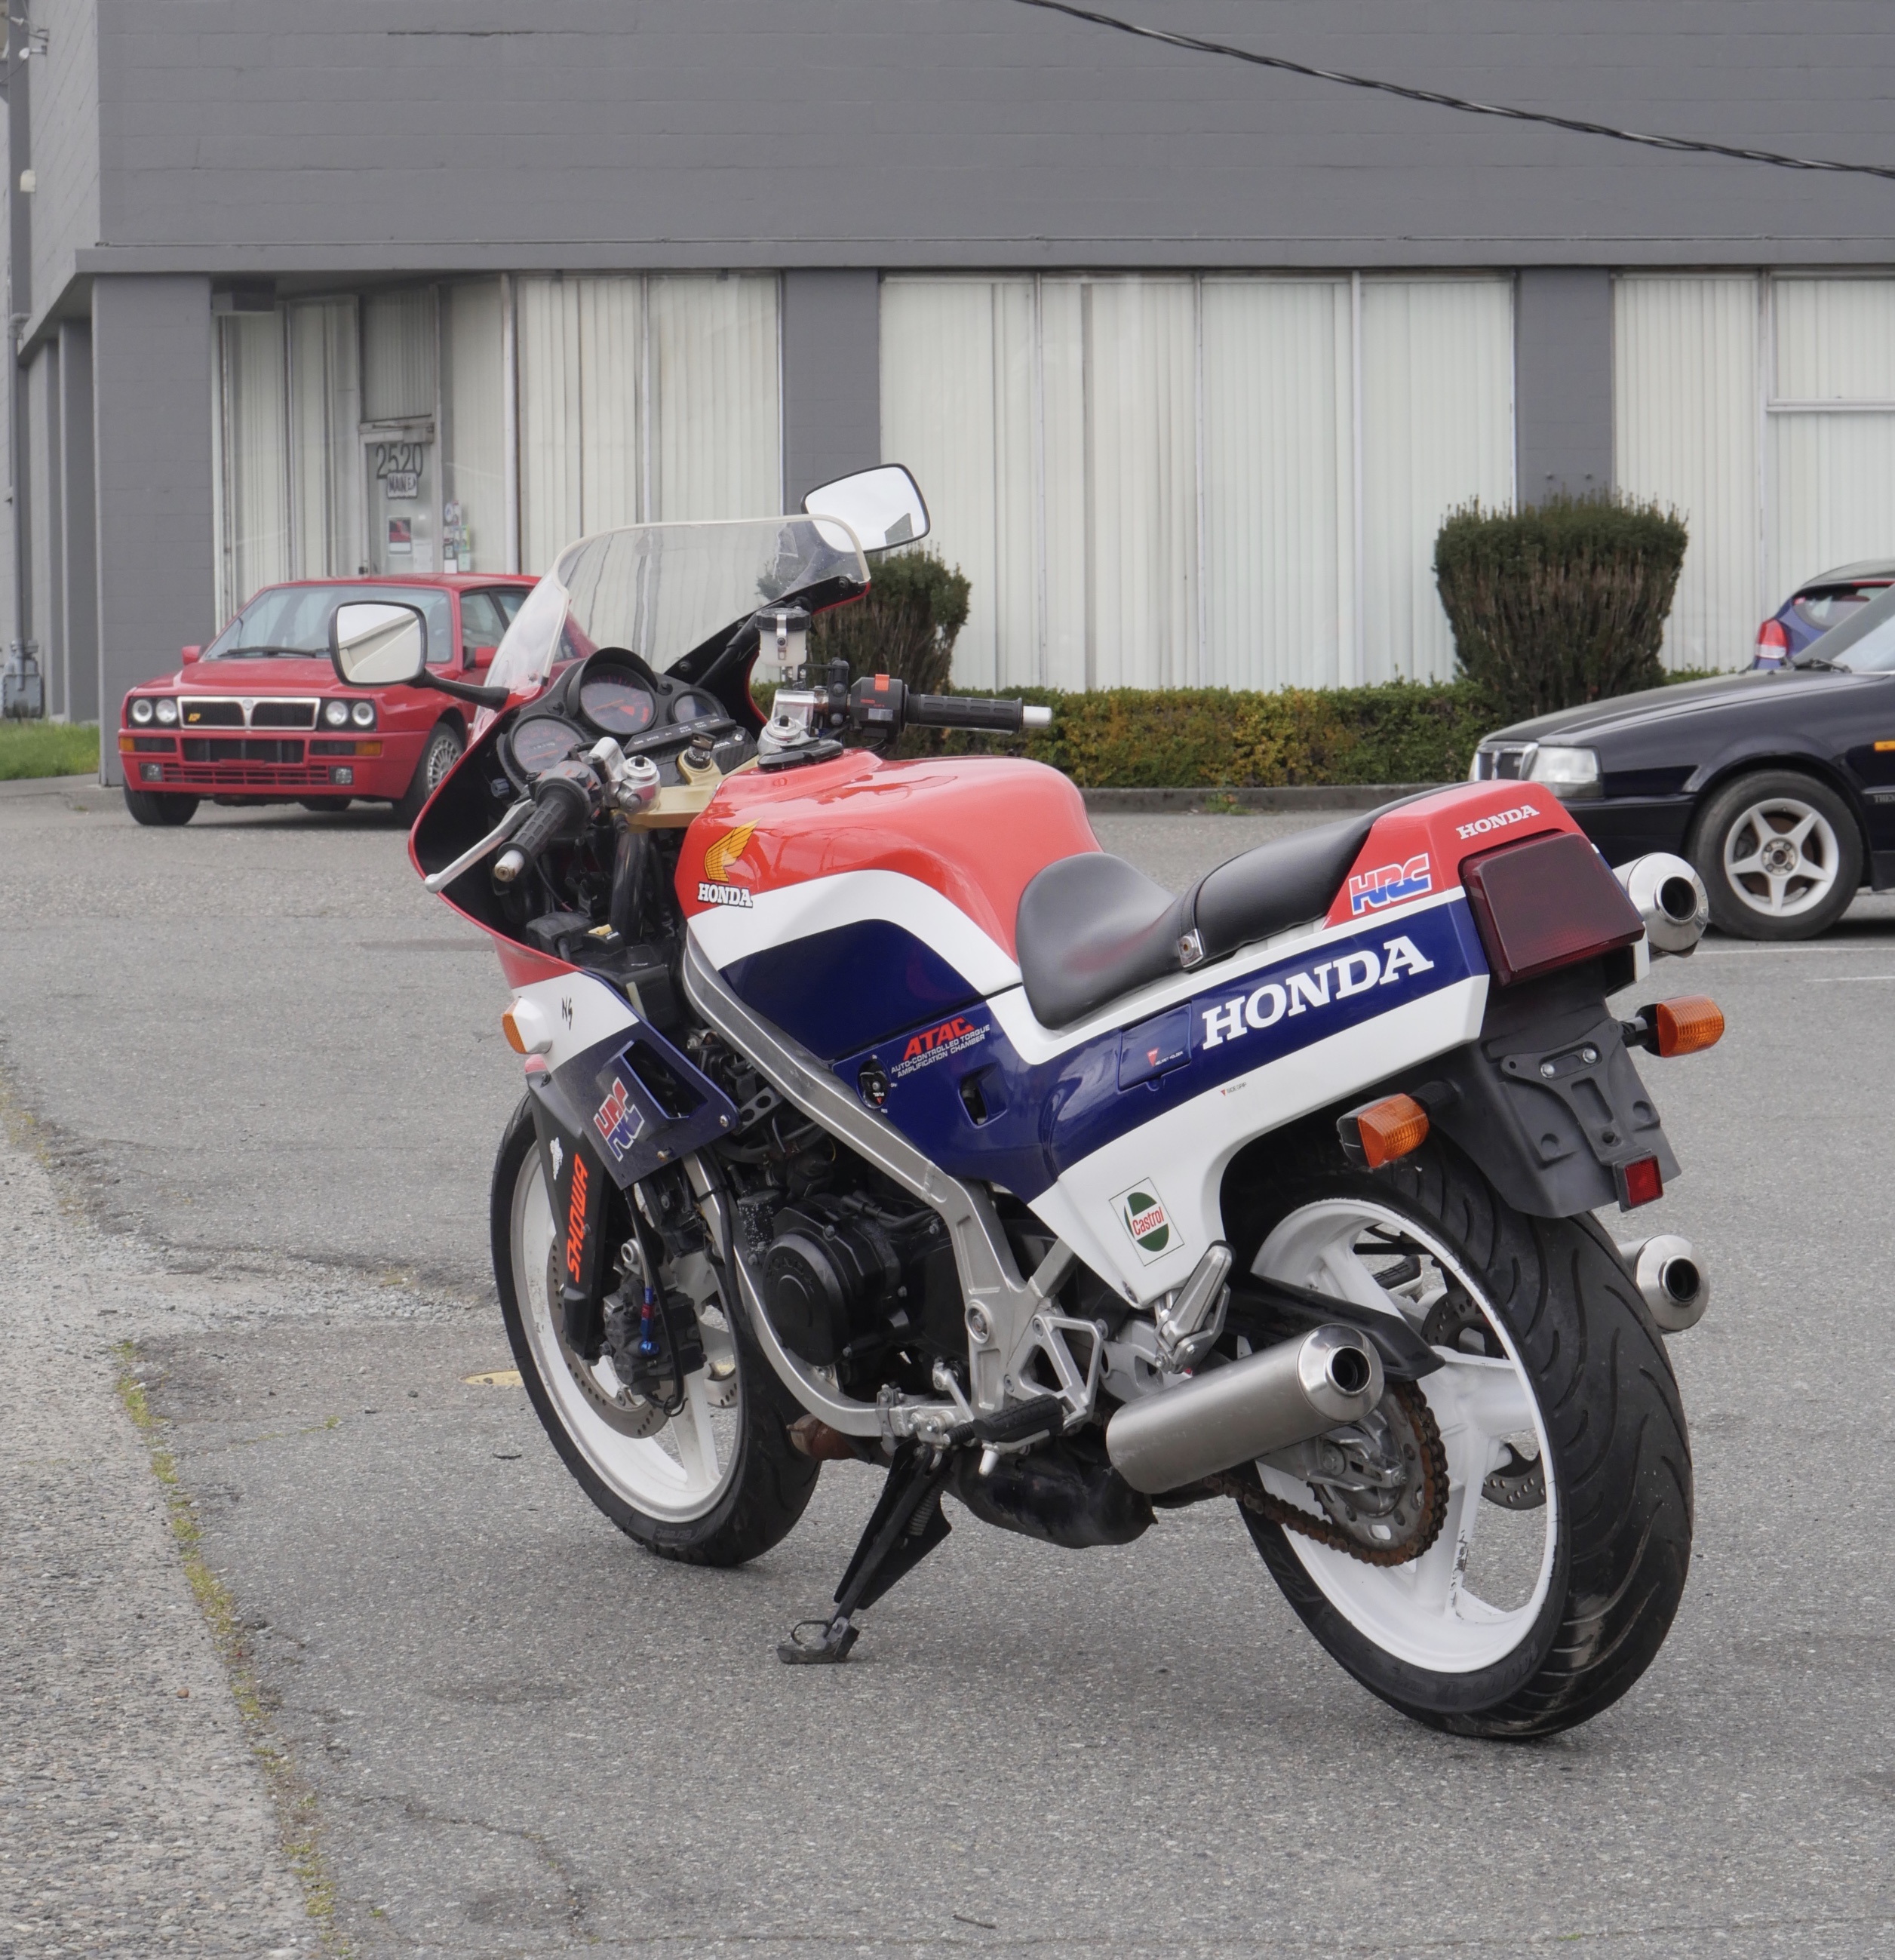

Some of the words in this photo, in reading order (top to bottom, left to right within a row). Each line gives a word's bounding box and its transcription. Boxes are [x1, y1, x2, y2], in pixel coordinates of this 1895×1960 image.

[376, 443, 423, 479] 2520
[1456, 804, 1540, 840] HONDA
[697, 882, 753, 908] HONDA
[1348, 852, 1433, 916] HRC
[1202, 935, 1434, 1050] HONDA
[891, 1038, 960, 1074] AUTO-CONTROLLED
[960, 1025, 990, 1043] TORQUE
[897, 1050, 948, 1078] AMPLIFICATION
[950, 1034, 985, 1054] CHAMBER
[903, 1015, 975, 1061] ATAC
[567, 1152, 588, 1283] SHOWA
[1132, 1206, 1165, 1236] Castrol
